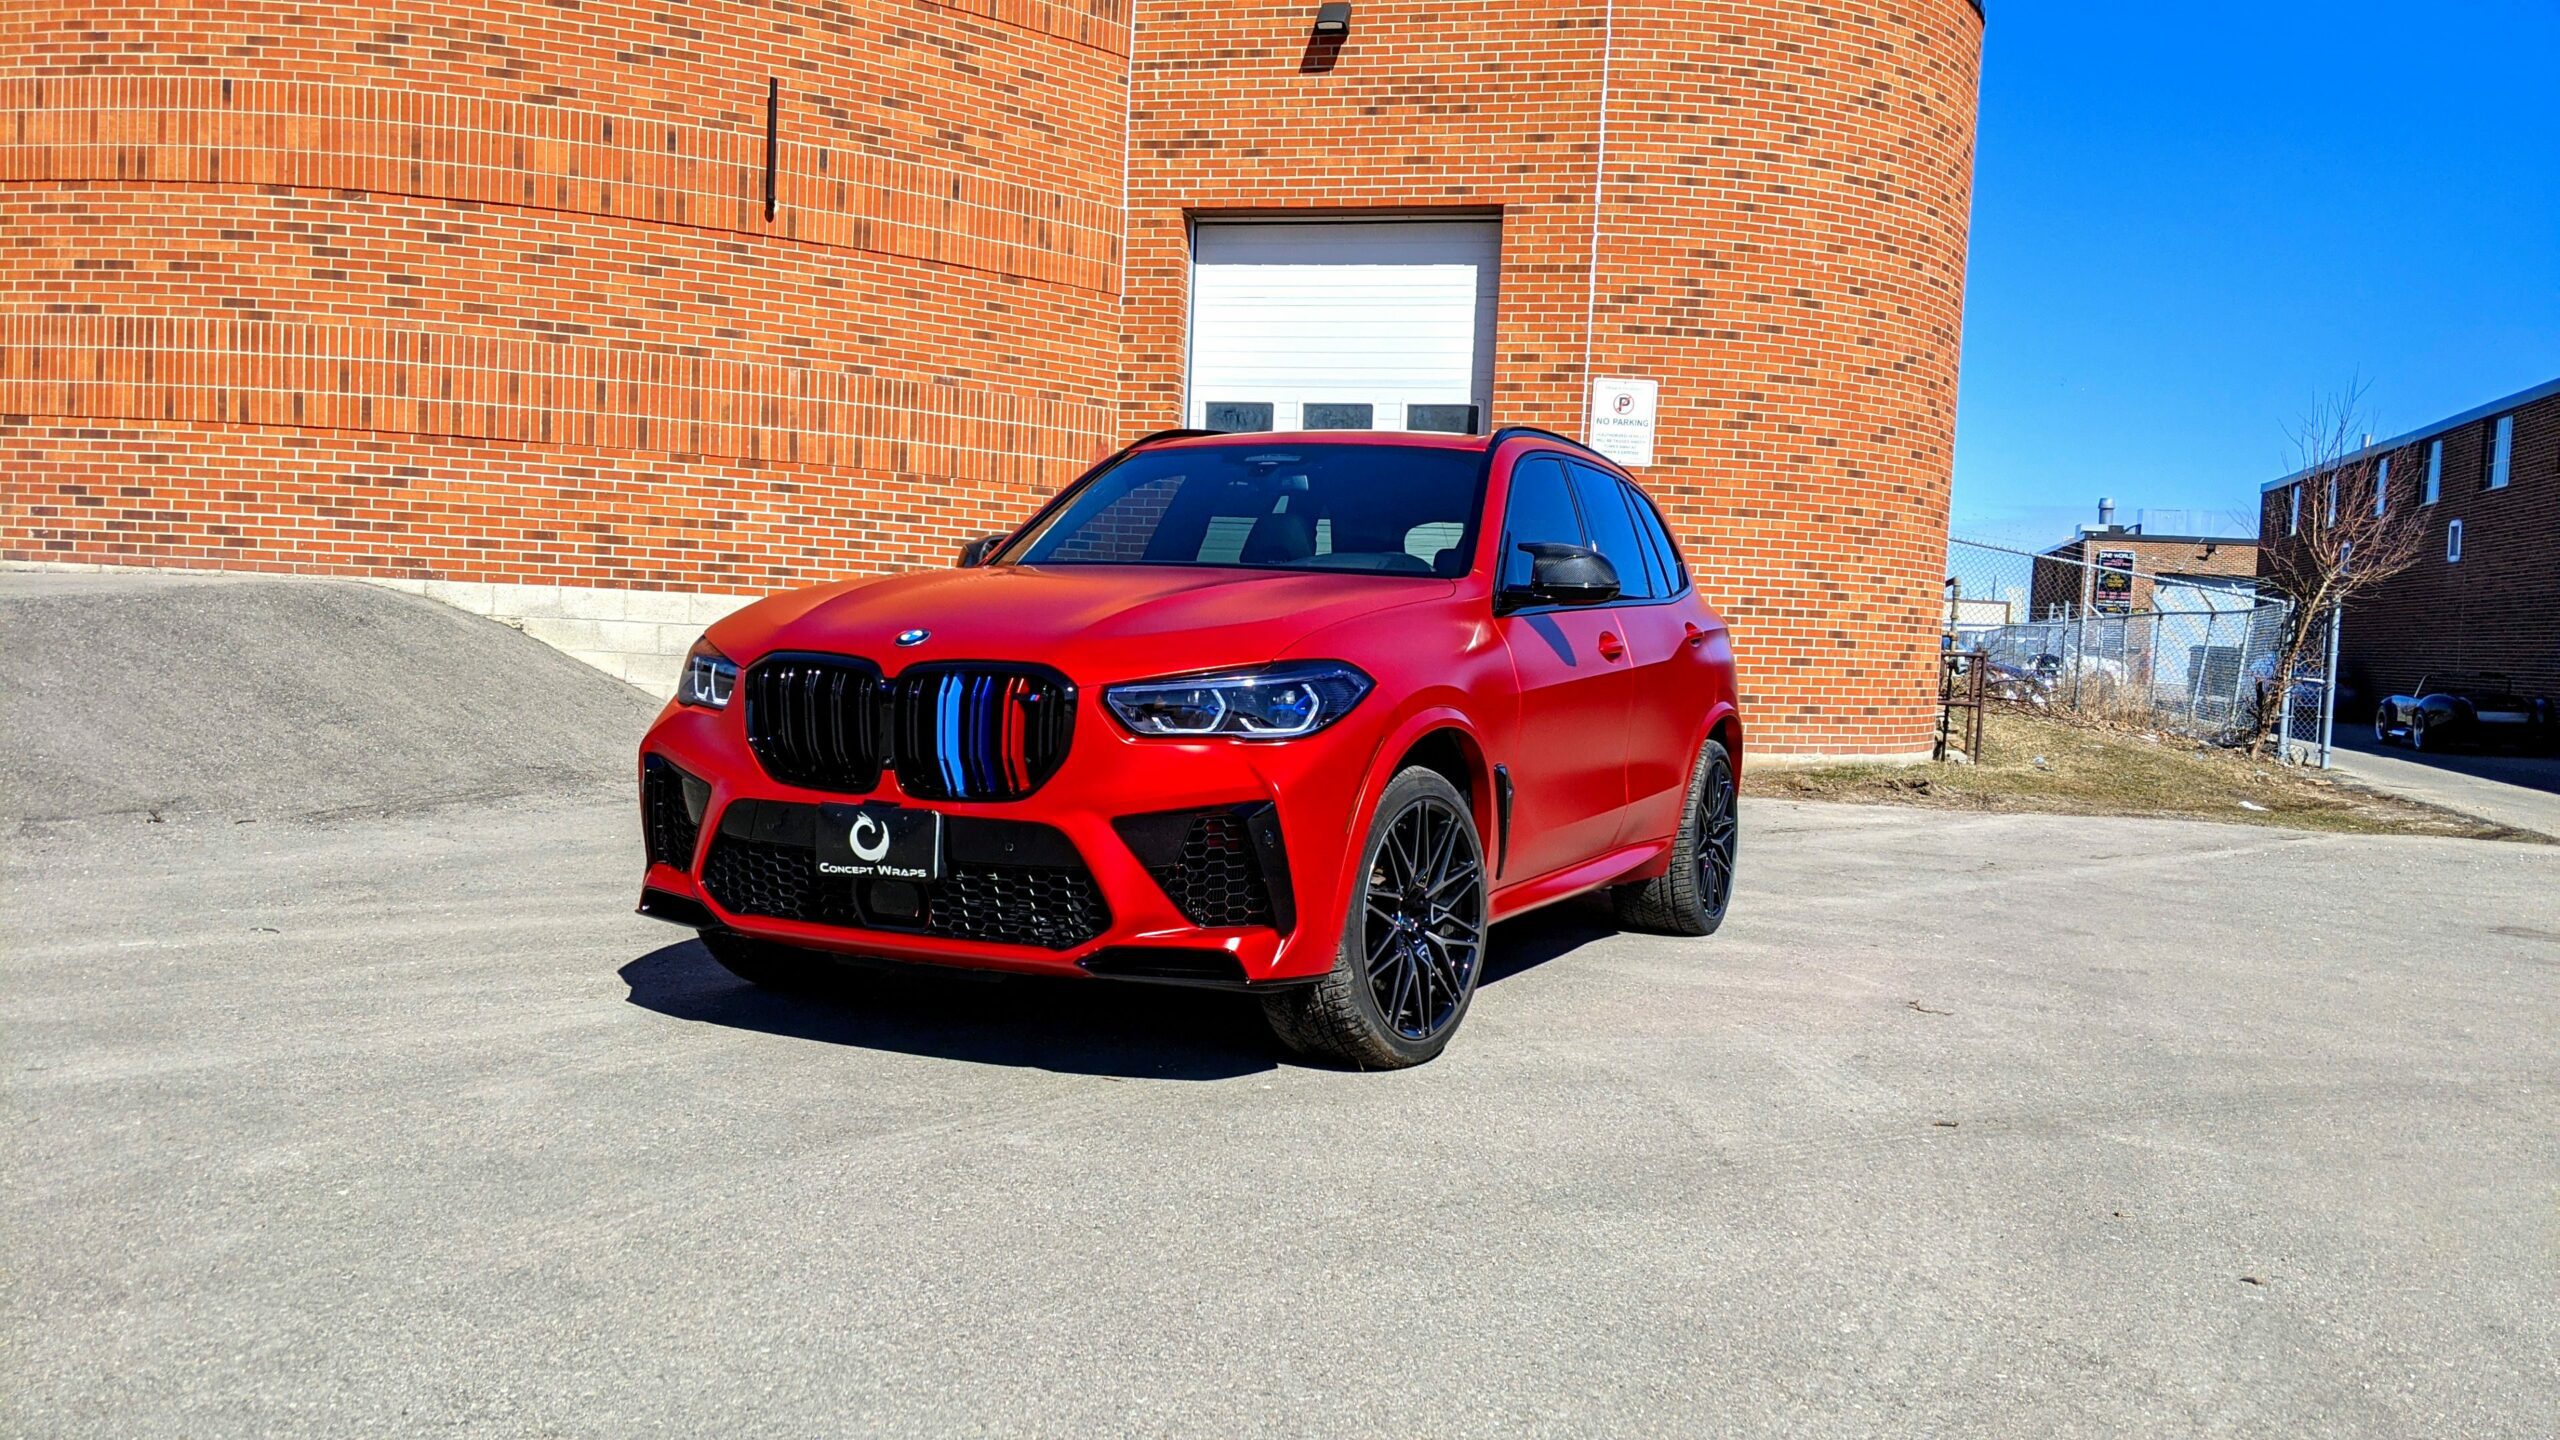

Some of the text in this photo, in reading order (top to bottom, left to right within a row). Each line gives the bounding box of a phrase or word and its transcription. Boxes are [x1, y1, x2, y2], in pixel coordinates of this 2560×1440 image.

[1613, 418, 1649, 427] PARKING
[820, 863, 926, 877] CONCEPT WRAPS
